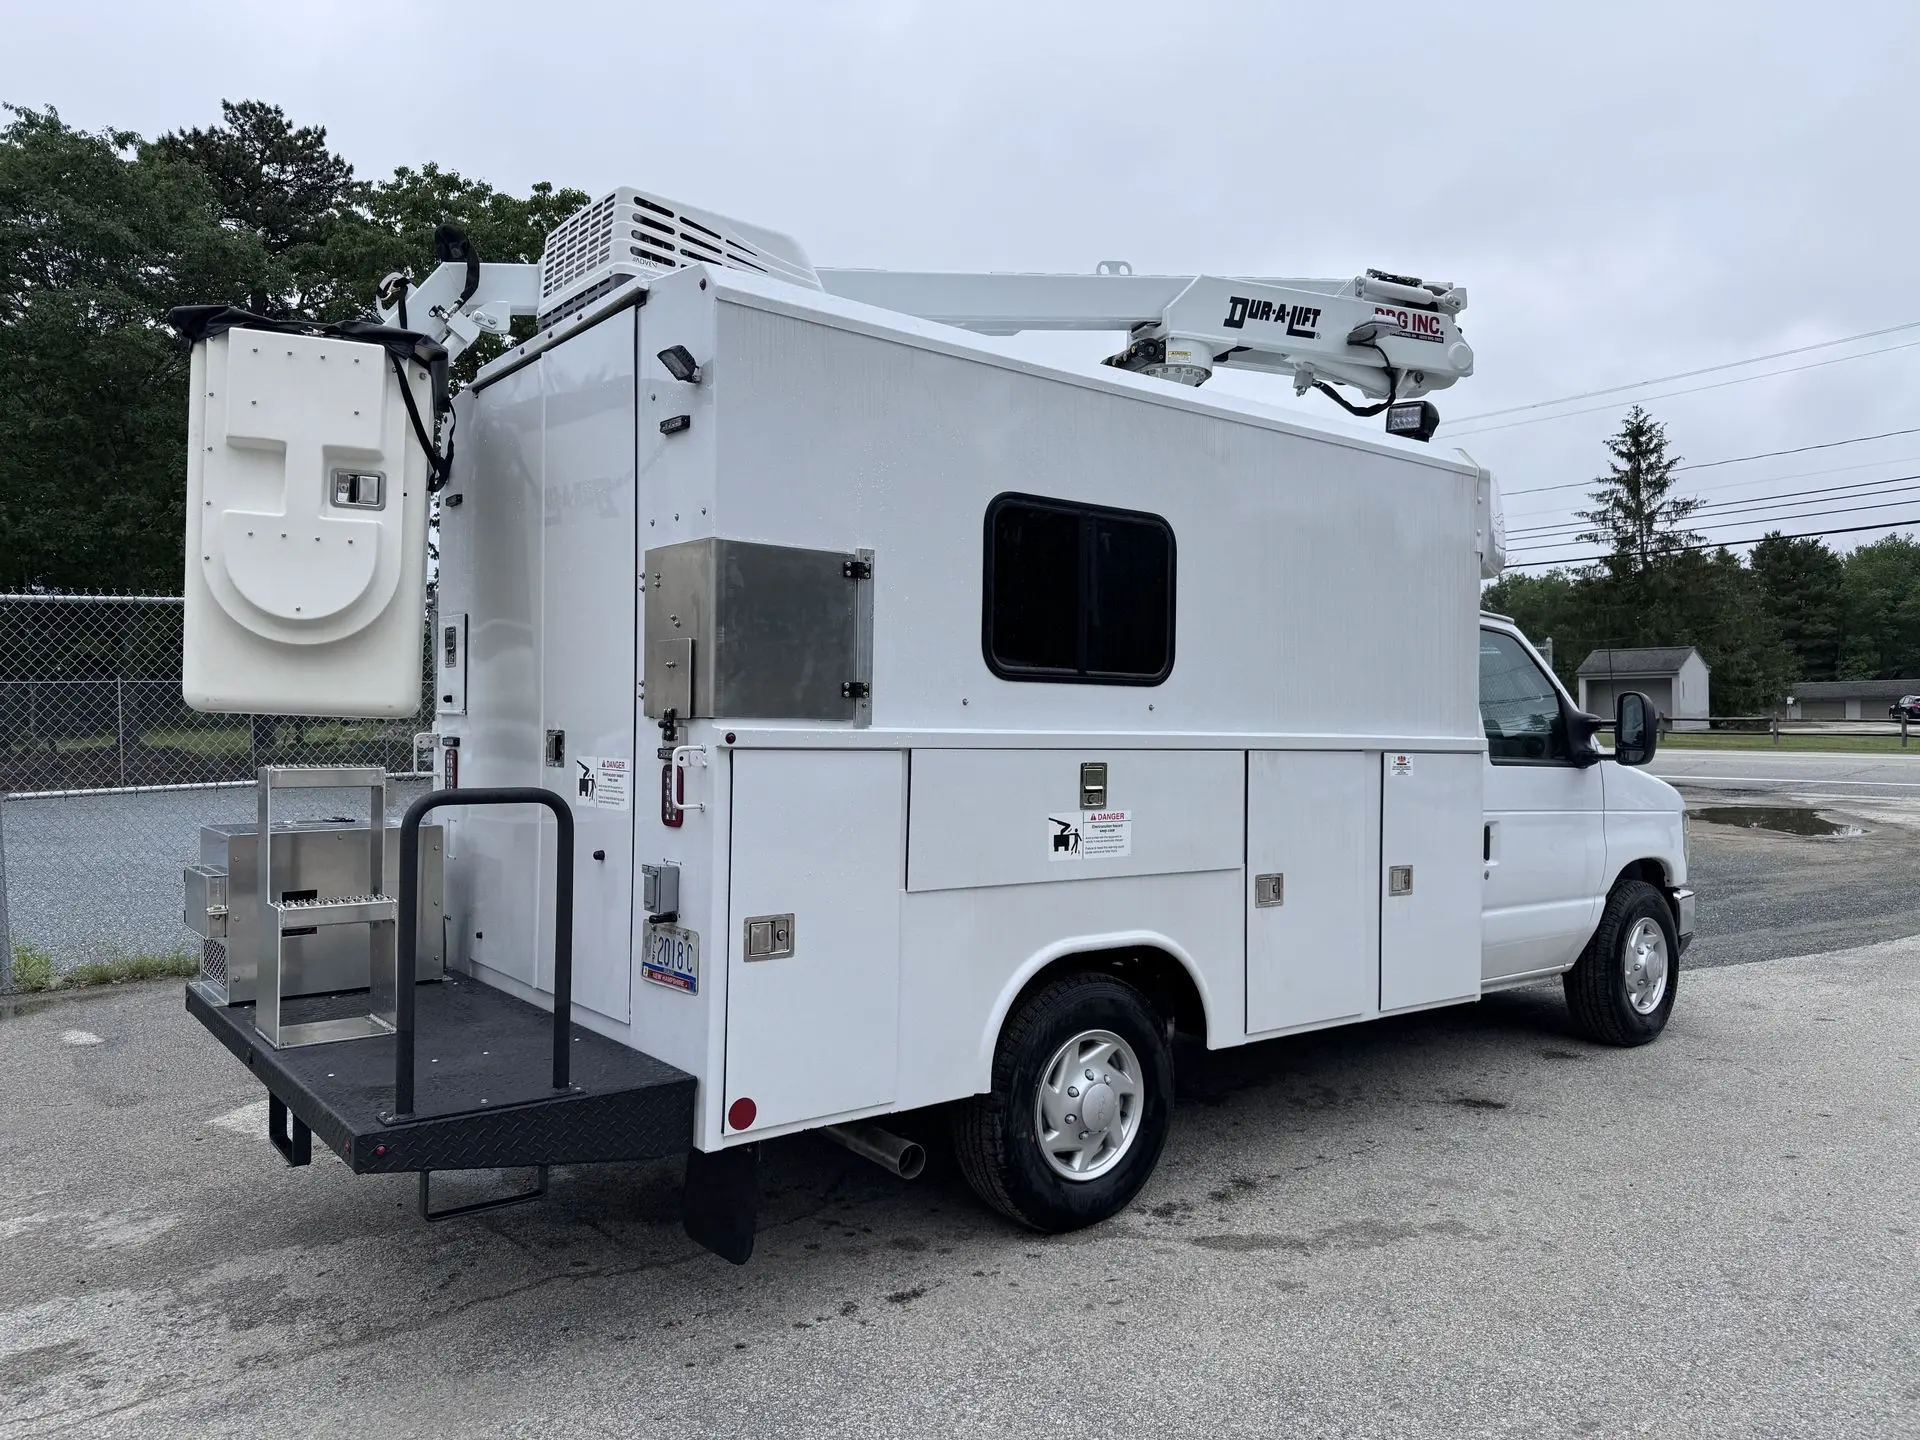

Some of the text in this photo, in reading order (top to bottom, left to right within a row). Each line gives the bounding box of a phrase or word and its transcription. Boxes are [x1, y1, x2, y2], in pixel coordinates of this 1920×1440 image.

[1412, 313, 1444, 335] INC.
[606, 760, 625, 769] DANGER
[1097, 813, 1125, 821] DANGER
